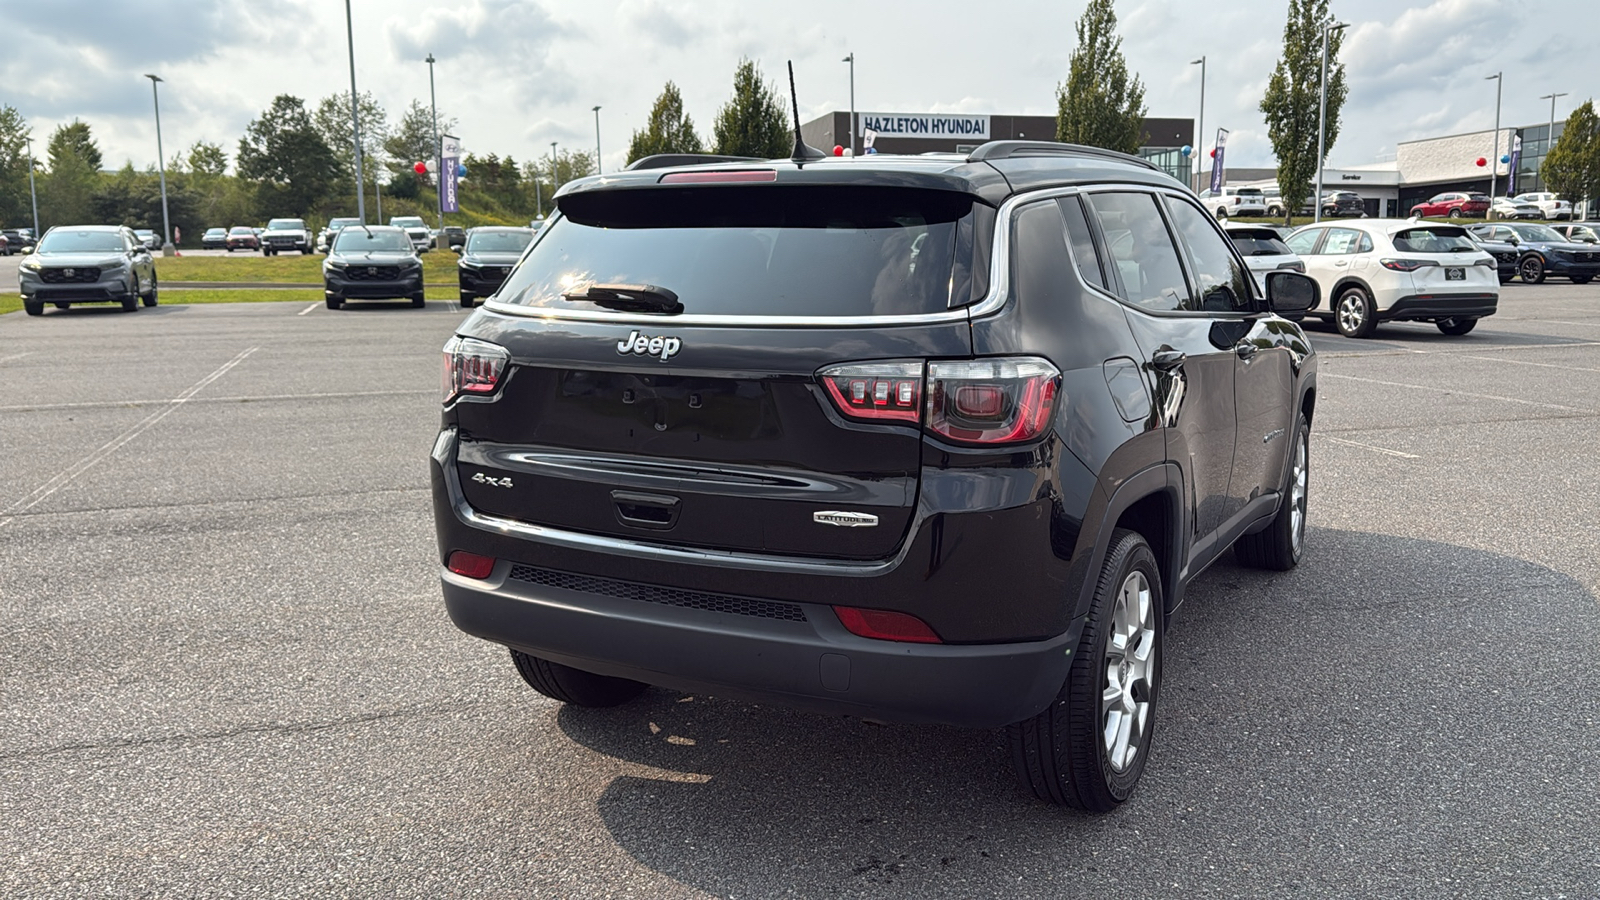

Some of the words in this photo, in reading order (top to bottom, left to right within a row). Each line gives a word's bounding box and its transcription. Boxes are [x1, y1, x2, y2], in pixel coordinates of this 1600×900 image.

[865, 116, 928, 133] HAZLETON
[932, 118, 985, 134] HYUNDAI
[447, 160, 455, 210] HYUNDAI
[616, 330, 682, 361] Jeep
[471, 472, 514, 488] 4x4
